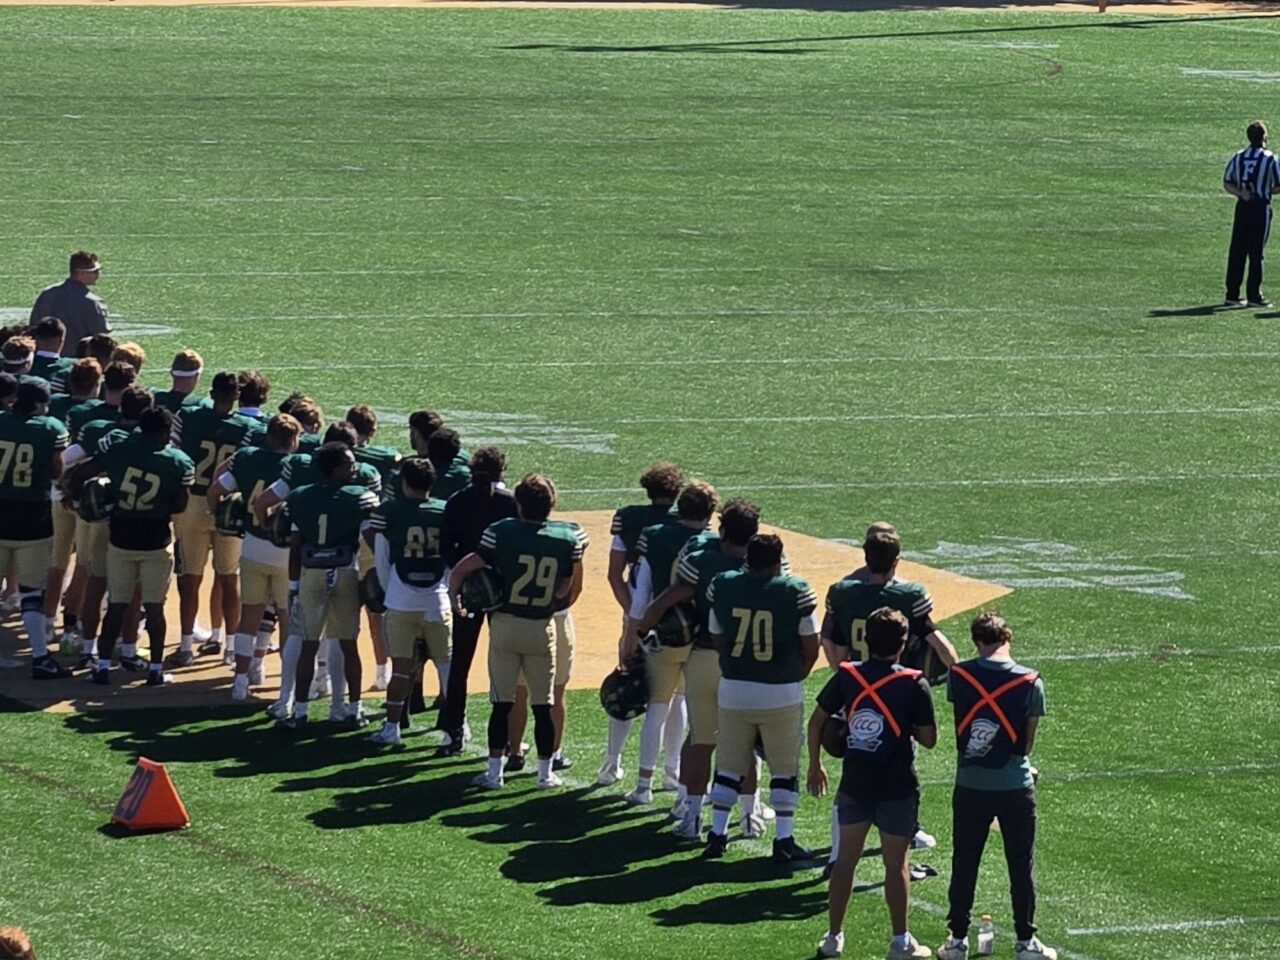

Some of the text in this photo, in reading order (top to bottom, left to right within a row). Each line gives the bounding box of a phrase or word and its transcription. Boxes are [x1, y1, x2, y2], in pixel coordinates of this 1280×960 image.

[1243, 160, 1258, 180] F
[0, 442, 34, 487] 78
[118, 465, 161, 511] 52
[317, 513, 329, 545] 1
[509, 554, 559, 607] 29
[731, 607, 774, 662] 70
